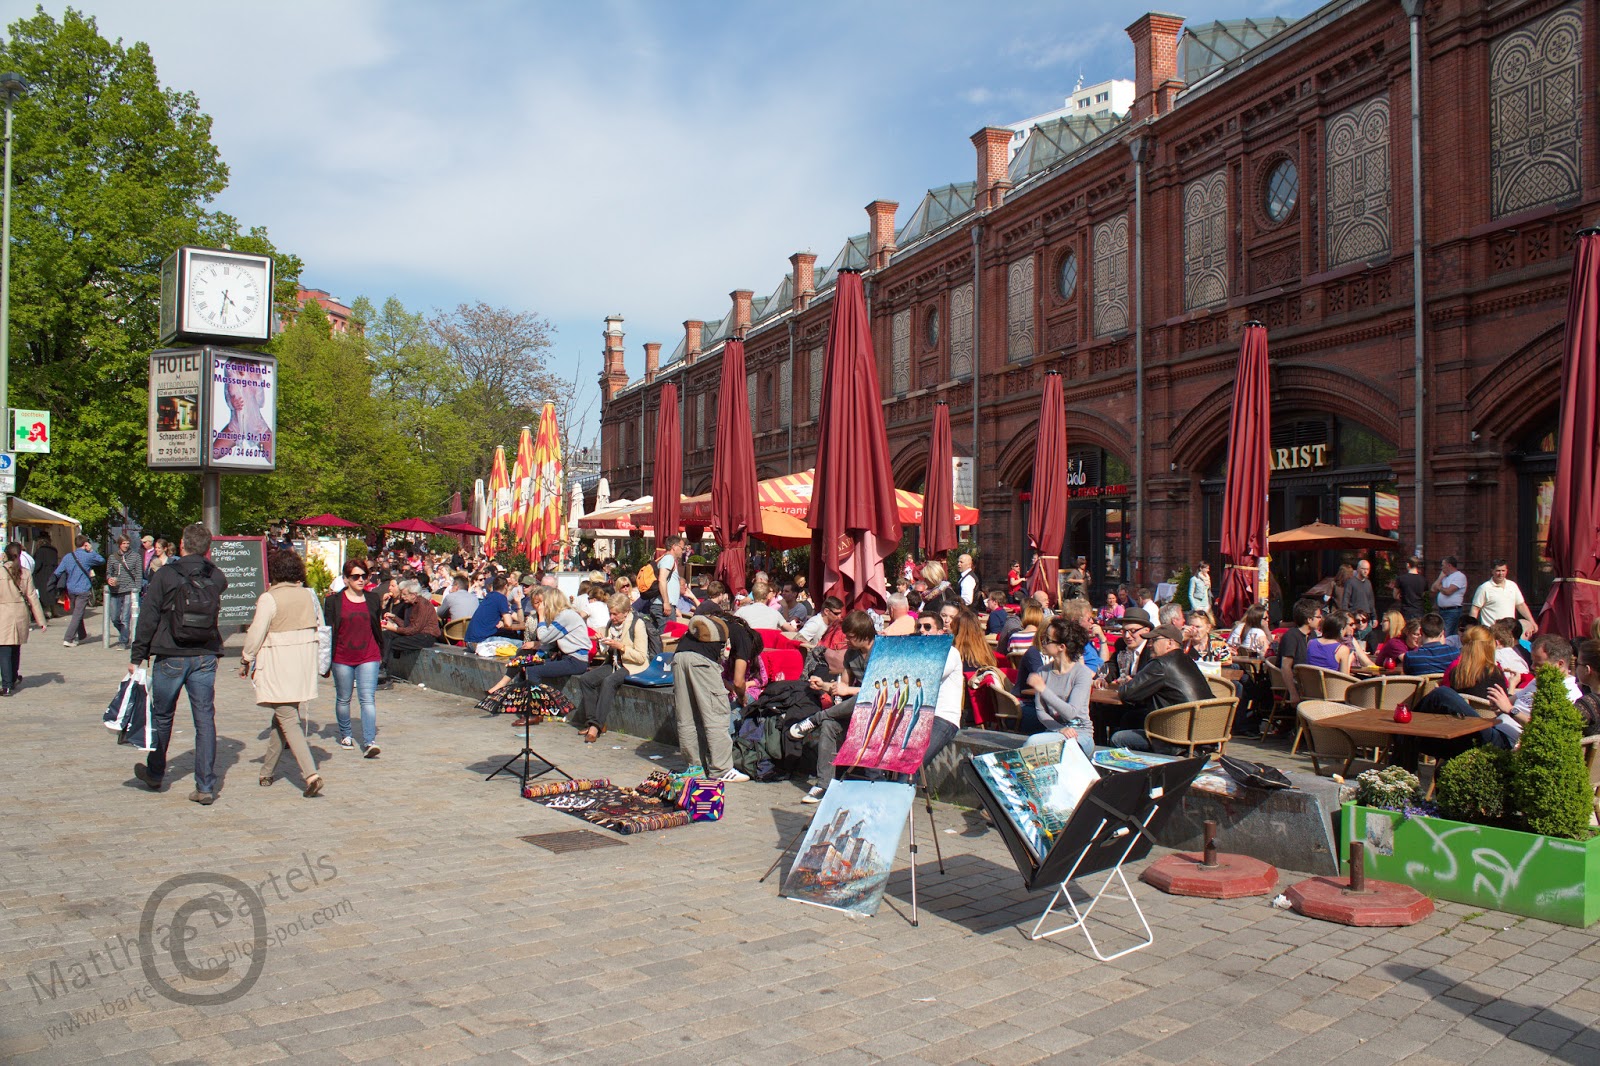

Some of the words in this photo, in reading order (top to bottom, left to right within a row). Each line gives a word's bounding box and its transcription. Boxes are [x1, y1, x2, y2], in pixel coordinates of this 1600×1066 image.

[158, 354, 199, 374] HOTEL
[214, 359, 271, 375] Dreamland-
[213, 374, 271, 388] Massagen.de
[159, 432, 188, 441] Schaperstr.
[213, 429, 245, 442] Danziger
